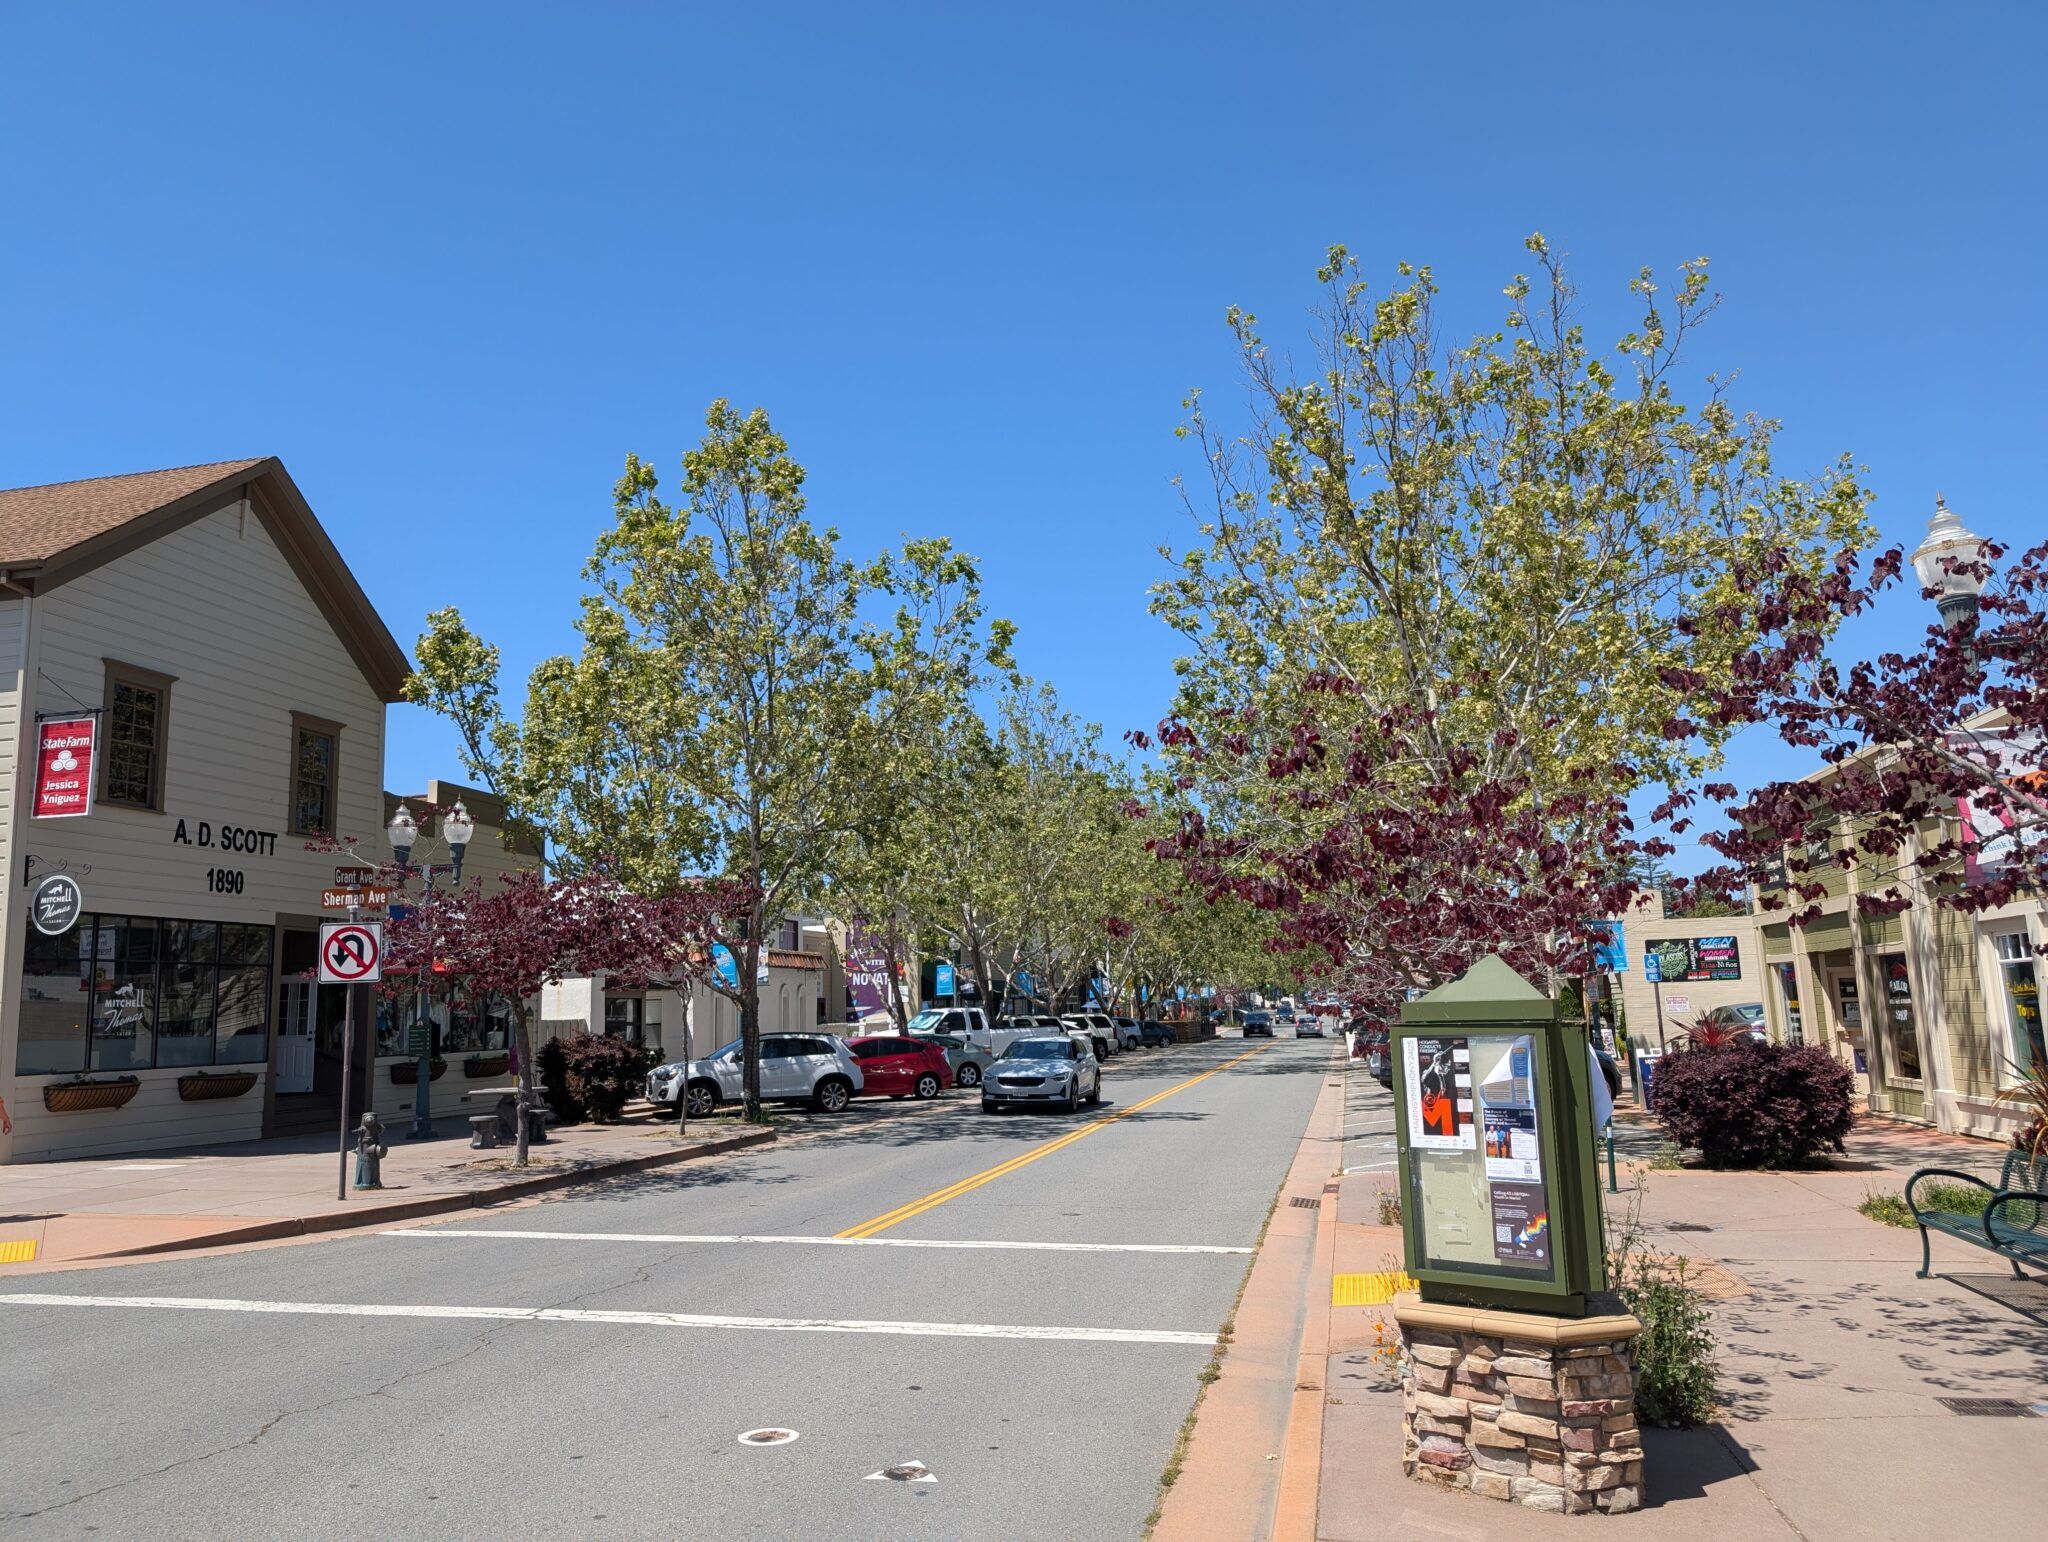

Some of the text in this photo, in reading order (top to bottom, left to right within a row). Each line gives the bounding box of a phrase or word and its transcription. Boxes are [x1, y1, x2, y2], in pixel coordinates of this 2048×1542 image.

[45, 780, 79, 790] Jessica
[43, 794, 80, 805] Yniguez
[173, 819, 278, 856] A. D. SCOTT
[207, 868, 244, 895] 1890
[335, 869, 373, 884] Grant Ave
[323, 890, 386, 906] Sherman Ave
[40, 904, 71, 921] Thomas
[1698, 937, 1734, 945] MEN
[1699, 949, 1735, 957] WOMEN
[864, 959, 886, 967] WITH
[852, 973, 889, 986] NOVAT
[2016, 1004, 2035, 1020] Toys
[104, 1009, 143, 1031] Thomas
